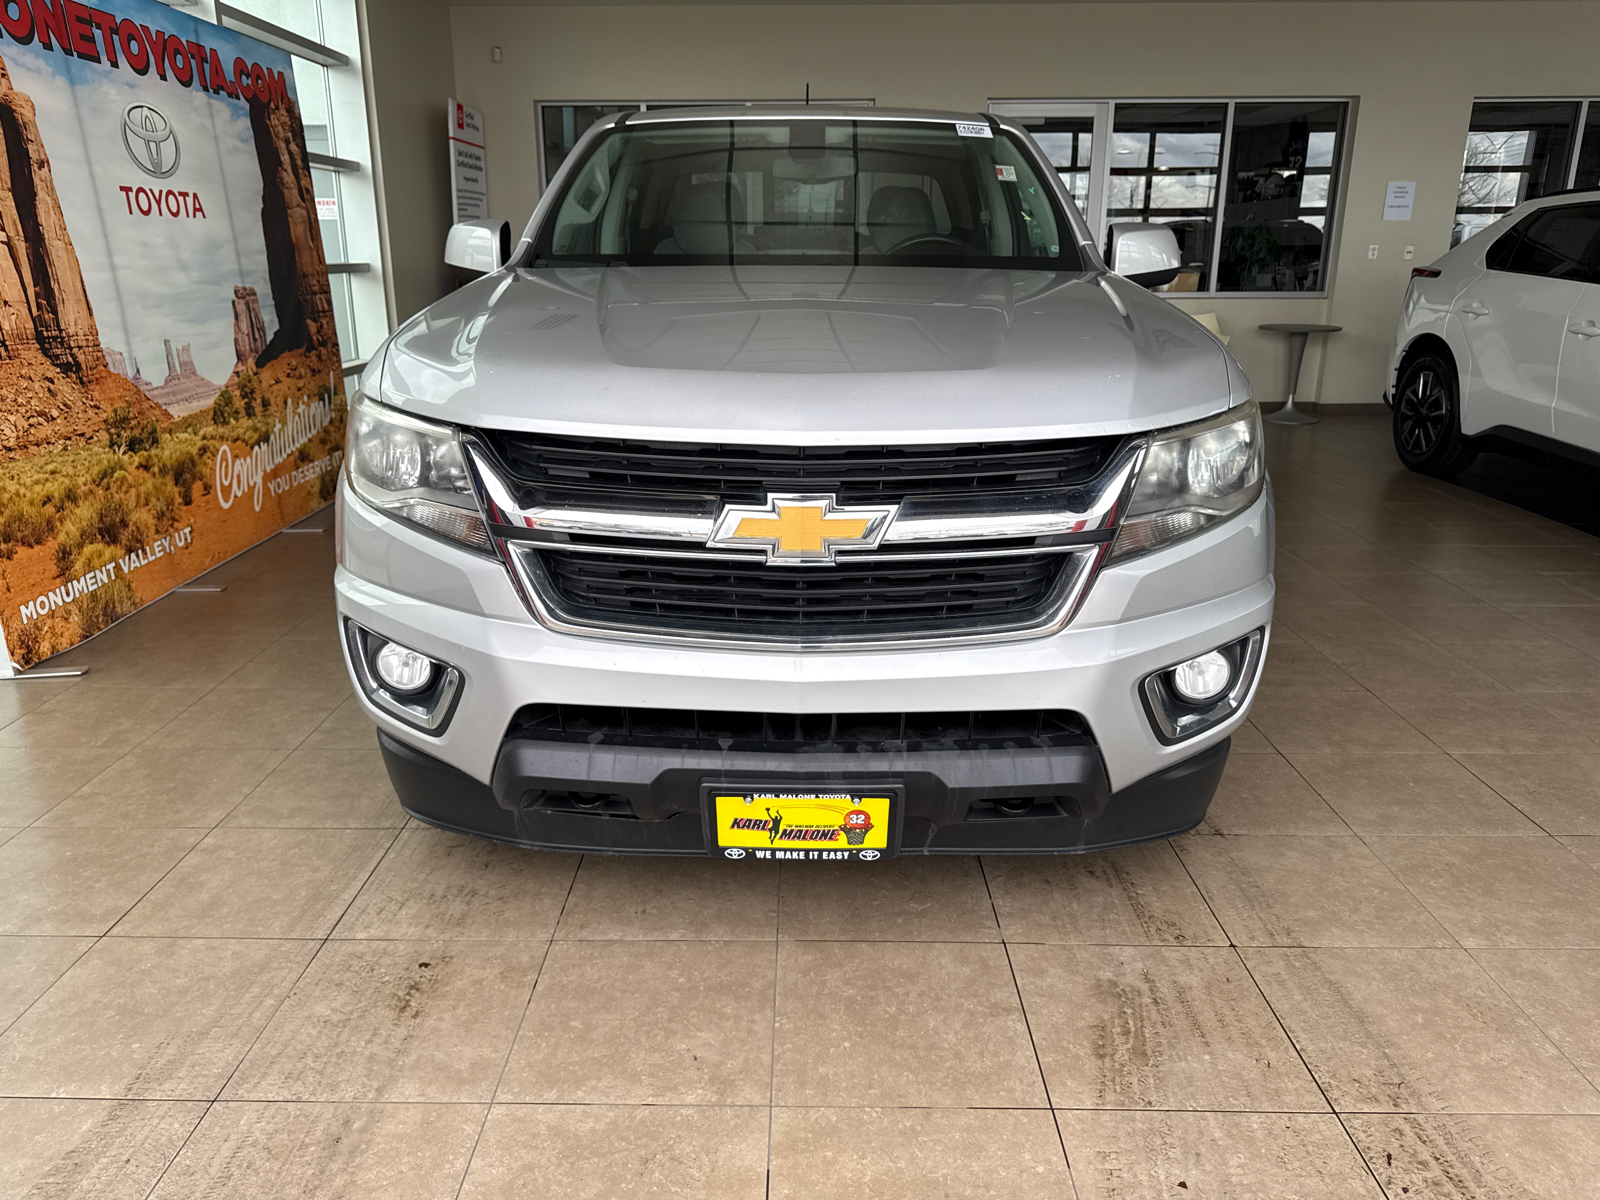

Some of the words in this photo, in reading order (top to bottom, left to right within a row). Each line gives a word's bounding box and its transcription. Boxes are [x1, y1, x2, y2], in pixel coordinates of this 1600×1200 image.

[0, 0, 290, 109] ONETOYOTA.COM
[119, 185, 207, 219] TOYOTA
[216, 370, 335, 512] Congratulations!
[268, 473, 290, 497] YOU
[291, 455, 332, 487] DESERVE
[19, 561, 116, 625] MONUMENT
[118, 536, 175, 574] VALLEY,
[174, 526, 192, 548] UT
[730, 818, 772, 832] KARL
[778, 828, 841, 841] MALONE
[850, 814, 866, 824] 32
[756, 850, 772, 858] WE
[776, 851, 804, 859] MAKE
[823, 852, 850, 860] EASY
